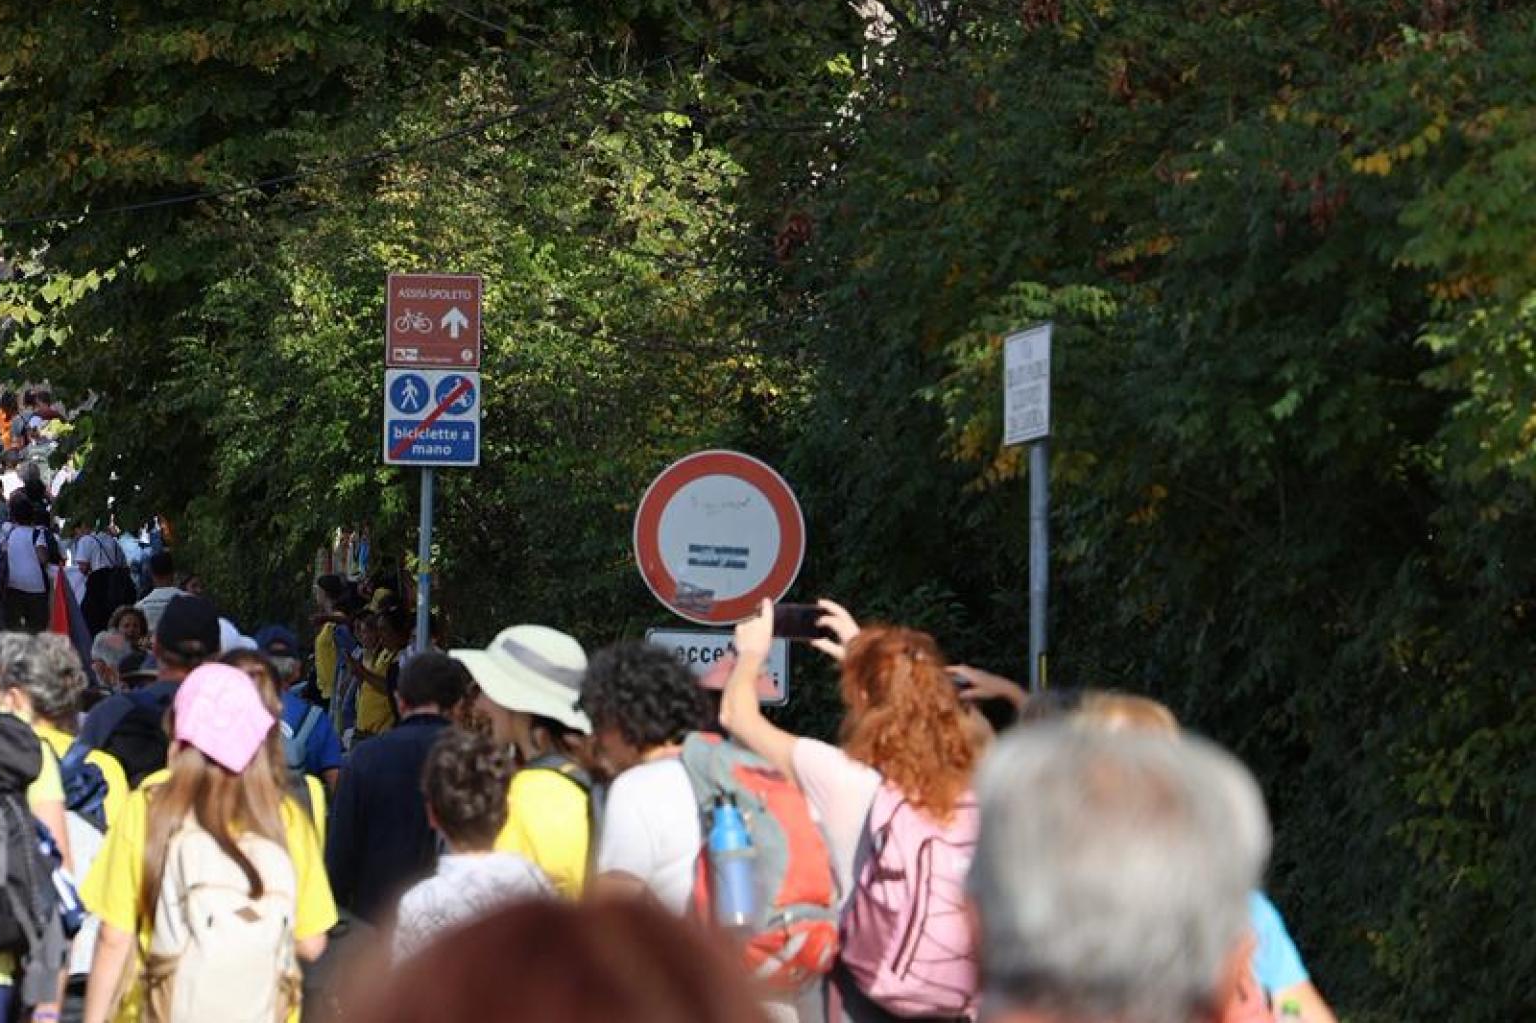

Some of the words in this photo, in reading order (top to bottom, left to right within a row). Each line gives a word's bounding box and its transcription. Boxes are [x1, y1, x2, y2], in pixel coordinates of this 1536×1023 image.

[394, 427, 457, 440] biciclette
[463, 430, 470, 440] a
[412, 444, 452, 455] mano
